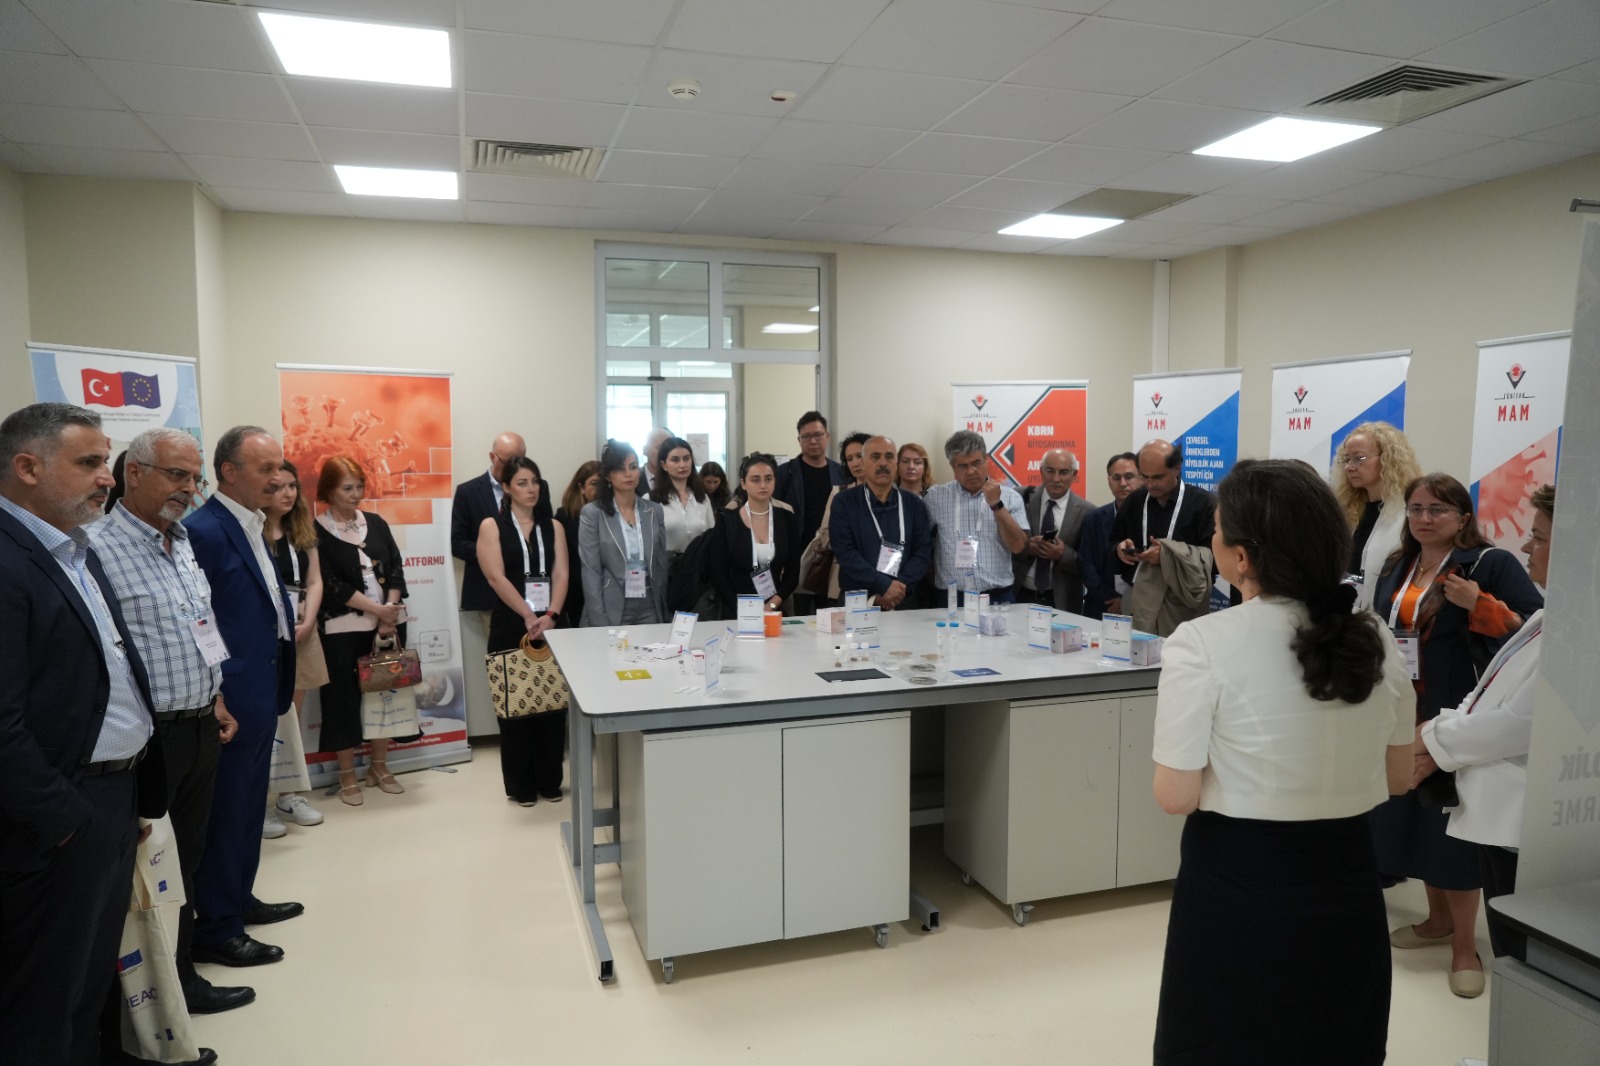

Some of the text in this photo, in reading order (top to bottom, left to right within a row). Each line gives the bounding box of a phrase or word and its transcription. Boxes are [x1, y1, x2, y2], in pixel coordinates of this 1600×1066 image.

[1498, 404, 1530, 421] MAM
[967, 422, 993, 432] MAM
[1147, 419, 1166, 430] MAM
[1289, 417, 1311, 430] MAM
[1028, 425, 1054, 436] KBRN
[1186, 436, 1209, 445] ÇEVRESEL
[1210, 460, 1224, 468] AJAN
[402, 556, 445, 567] ATFORMU
